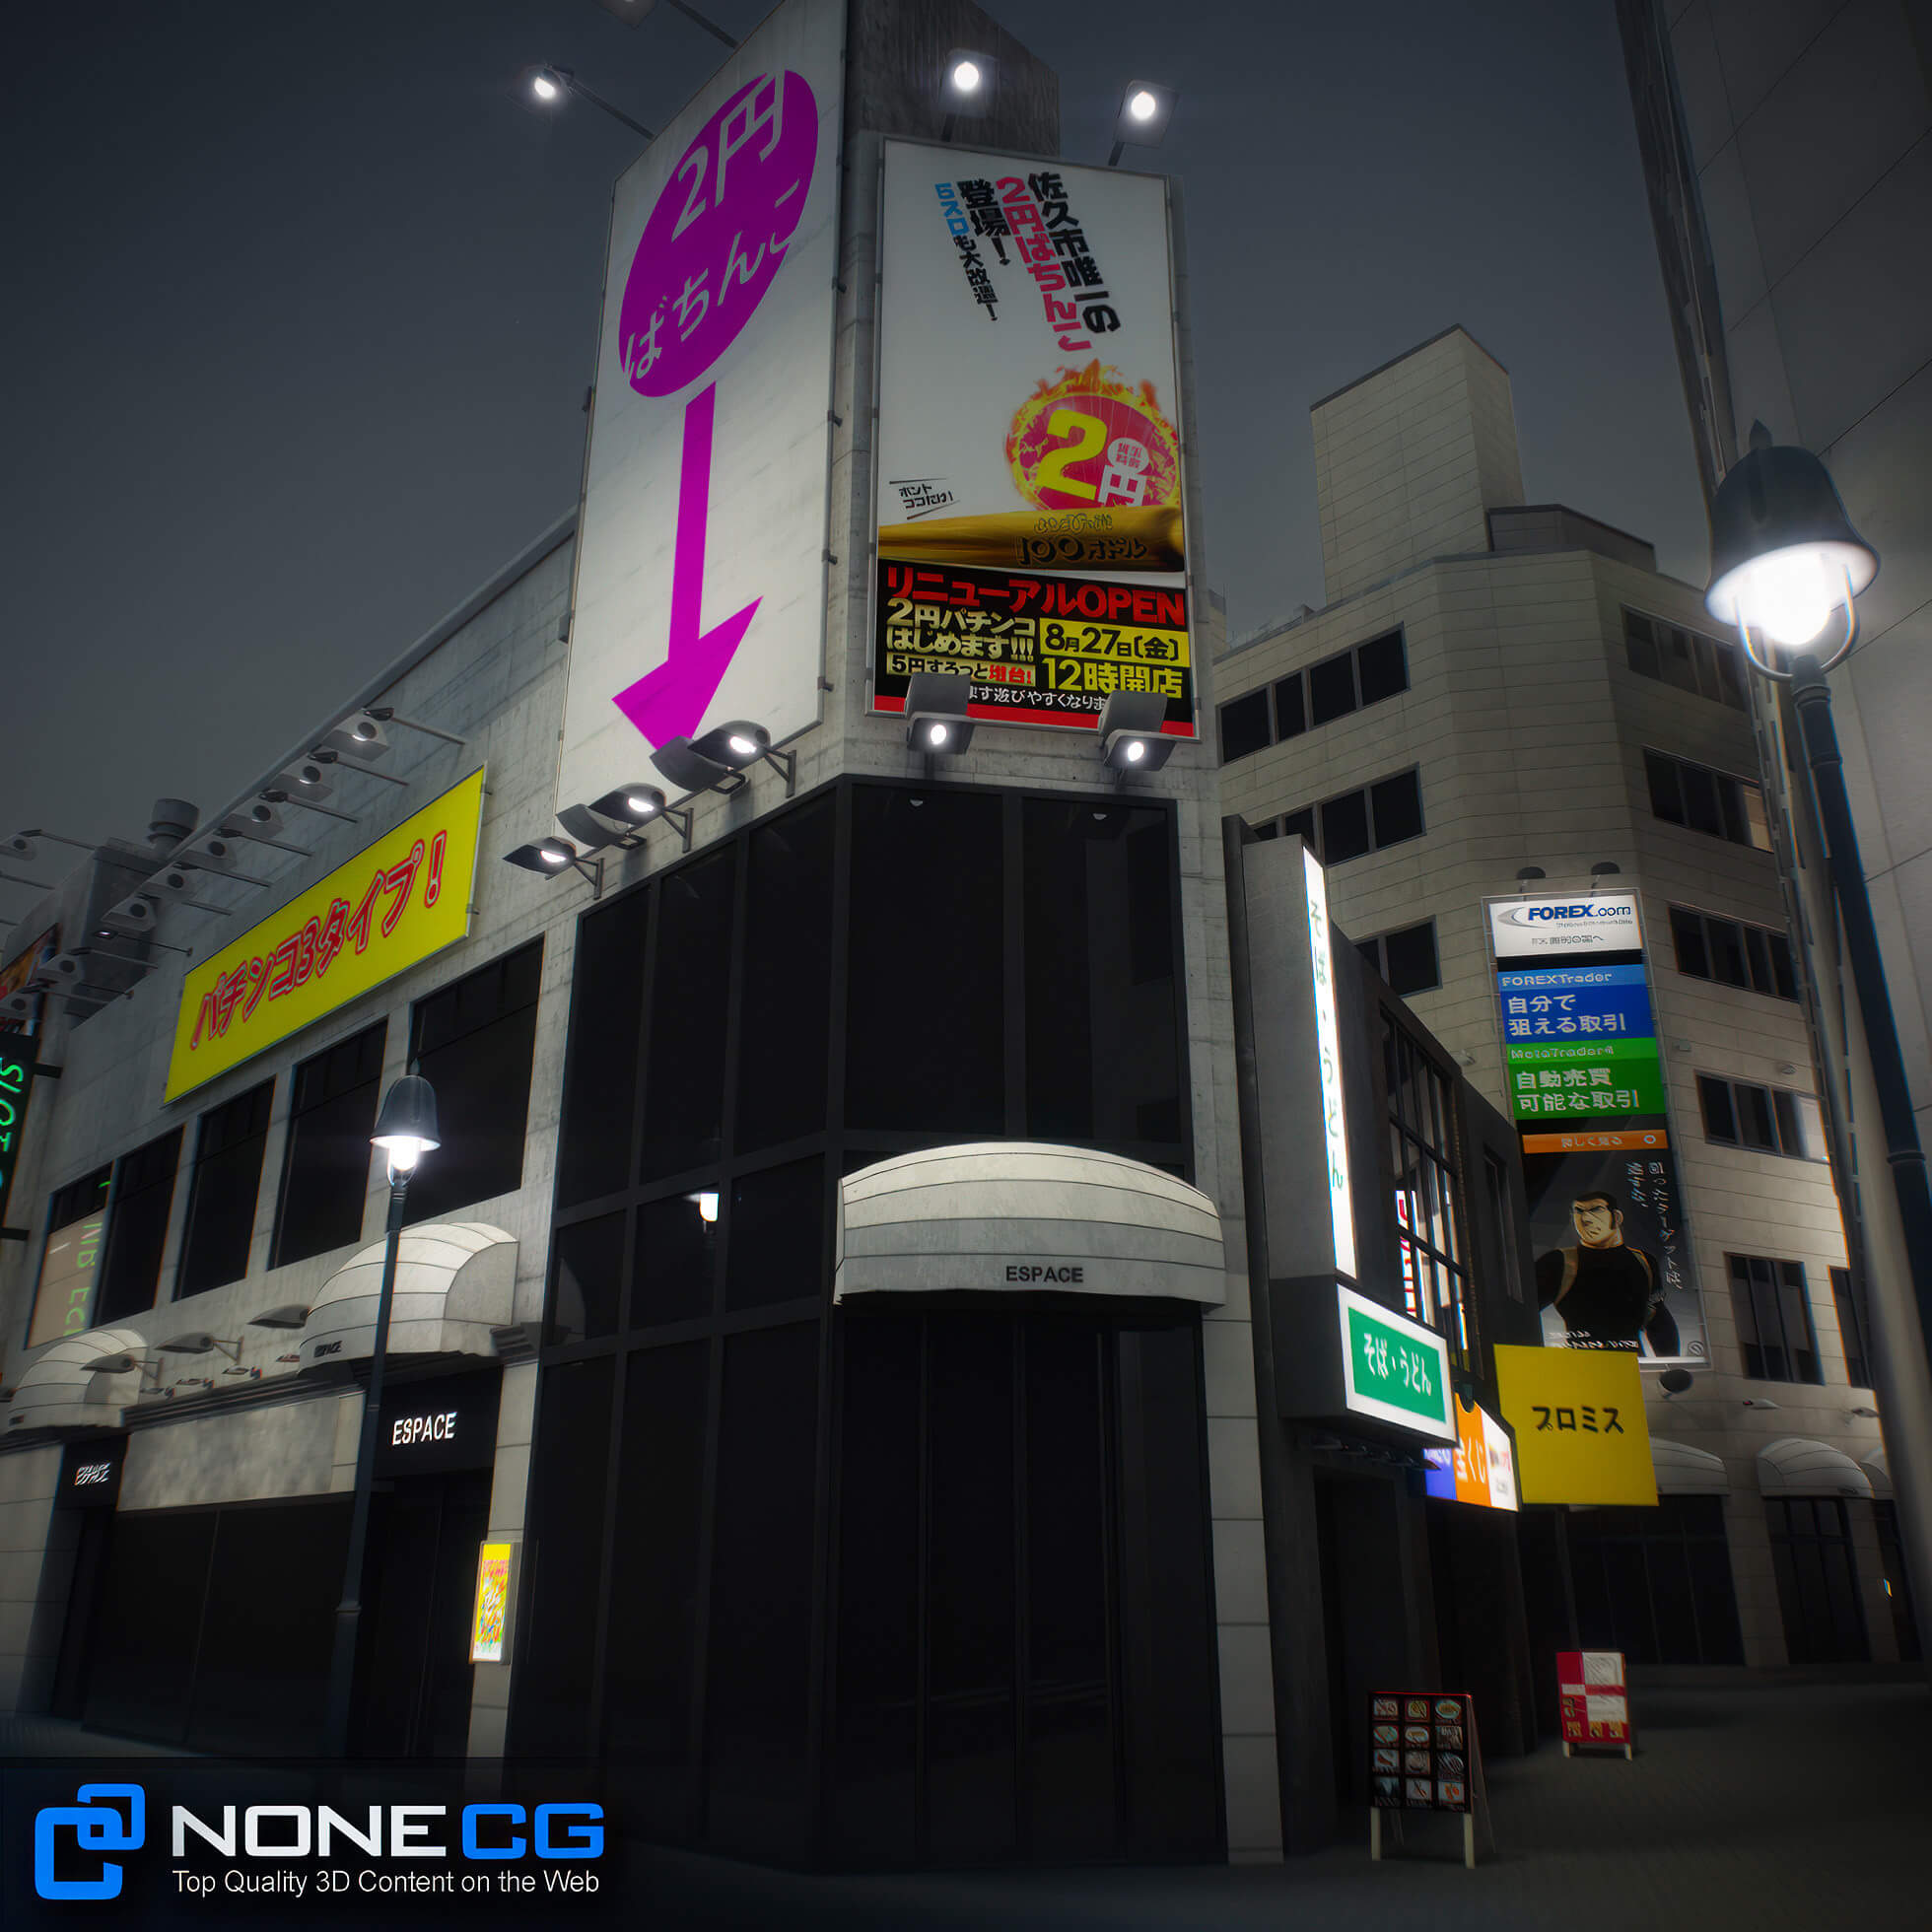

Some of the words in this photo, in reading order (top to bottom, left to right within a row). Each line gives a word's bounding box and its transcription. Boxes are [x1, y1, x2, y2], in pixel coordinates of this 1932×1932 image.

[671, 69, 786, 243] 2円
[1028, 172, 1121, 333] 佐久市唯一の
[887, 597, 1035, 638] 2円パチンコ
[1041, 657, 1182, 699] 12時開店
[1508, 995, 1576, 1014] 自分で
[1508, 1012, 1626, 1036] 狙える取引
[1516, 1068, 1613, 1089] 自動売買
[1518, 1089, 1639, 1112] 可能な取引
[1005, 1266, 1083, 1283] ESPACE
[392, 1411, 457, 1446] ESPACE
